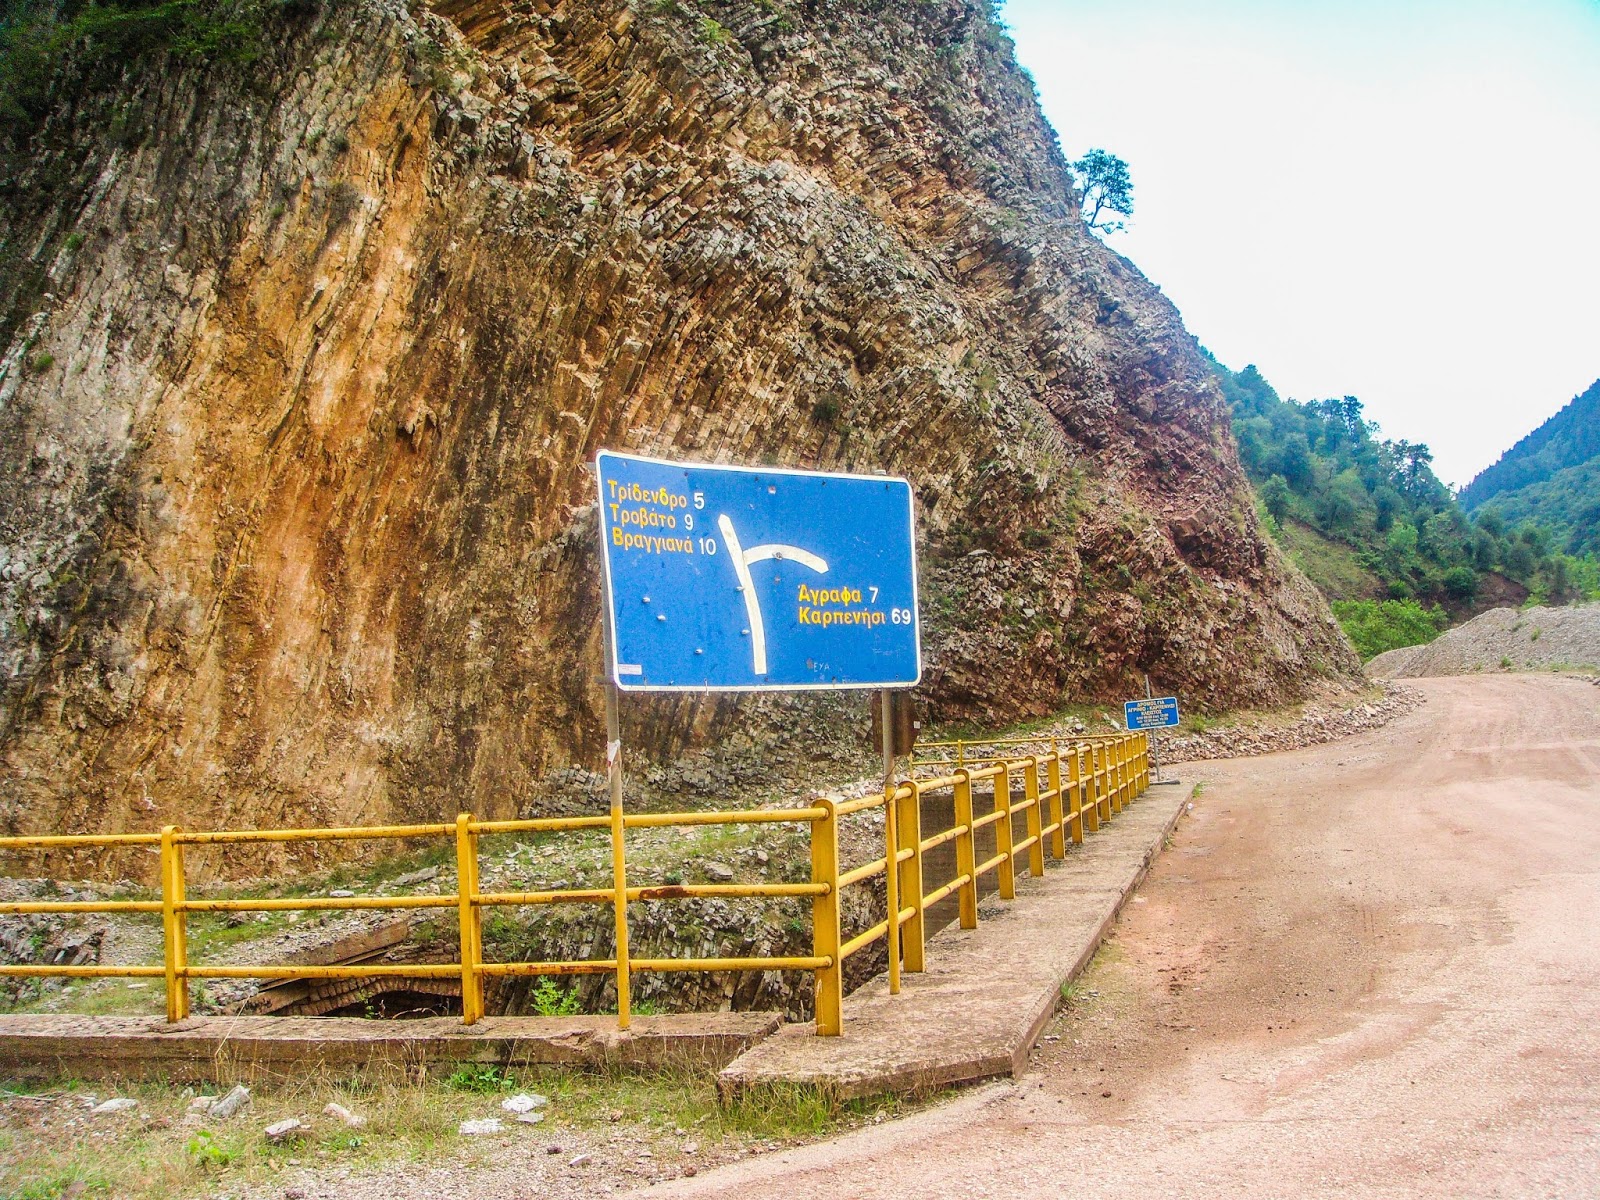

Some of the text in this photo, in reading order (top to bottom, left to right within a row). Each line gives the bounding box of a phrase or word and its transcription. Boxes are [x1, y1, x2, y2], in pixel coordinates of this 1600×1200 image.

[607, 479, 705, 512] Τρίδενδρο 5
[609, 503, 694, 531] Τροβάτο 9
[612, 526, 717, 556] Βραγγιανά 10
[797, 583, 880, 607] Άγραφα 7
[798, 606, 912, 629] Καρπενήσι 69
